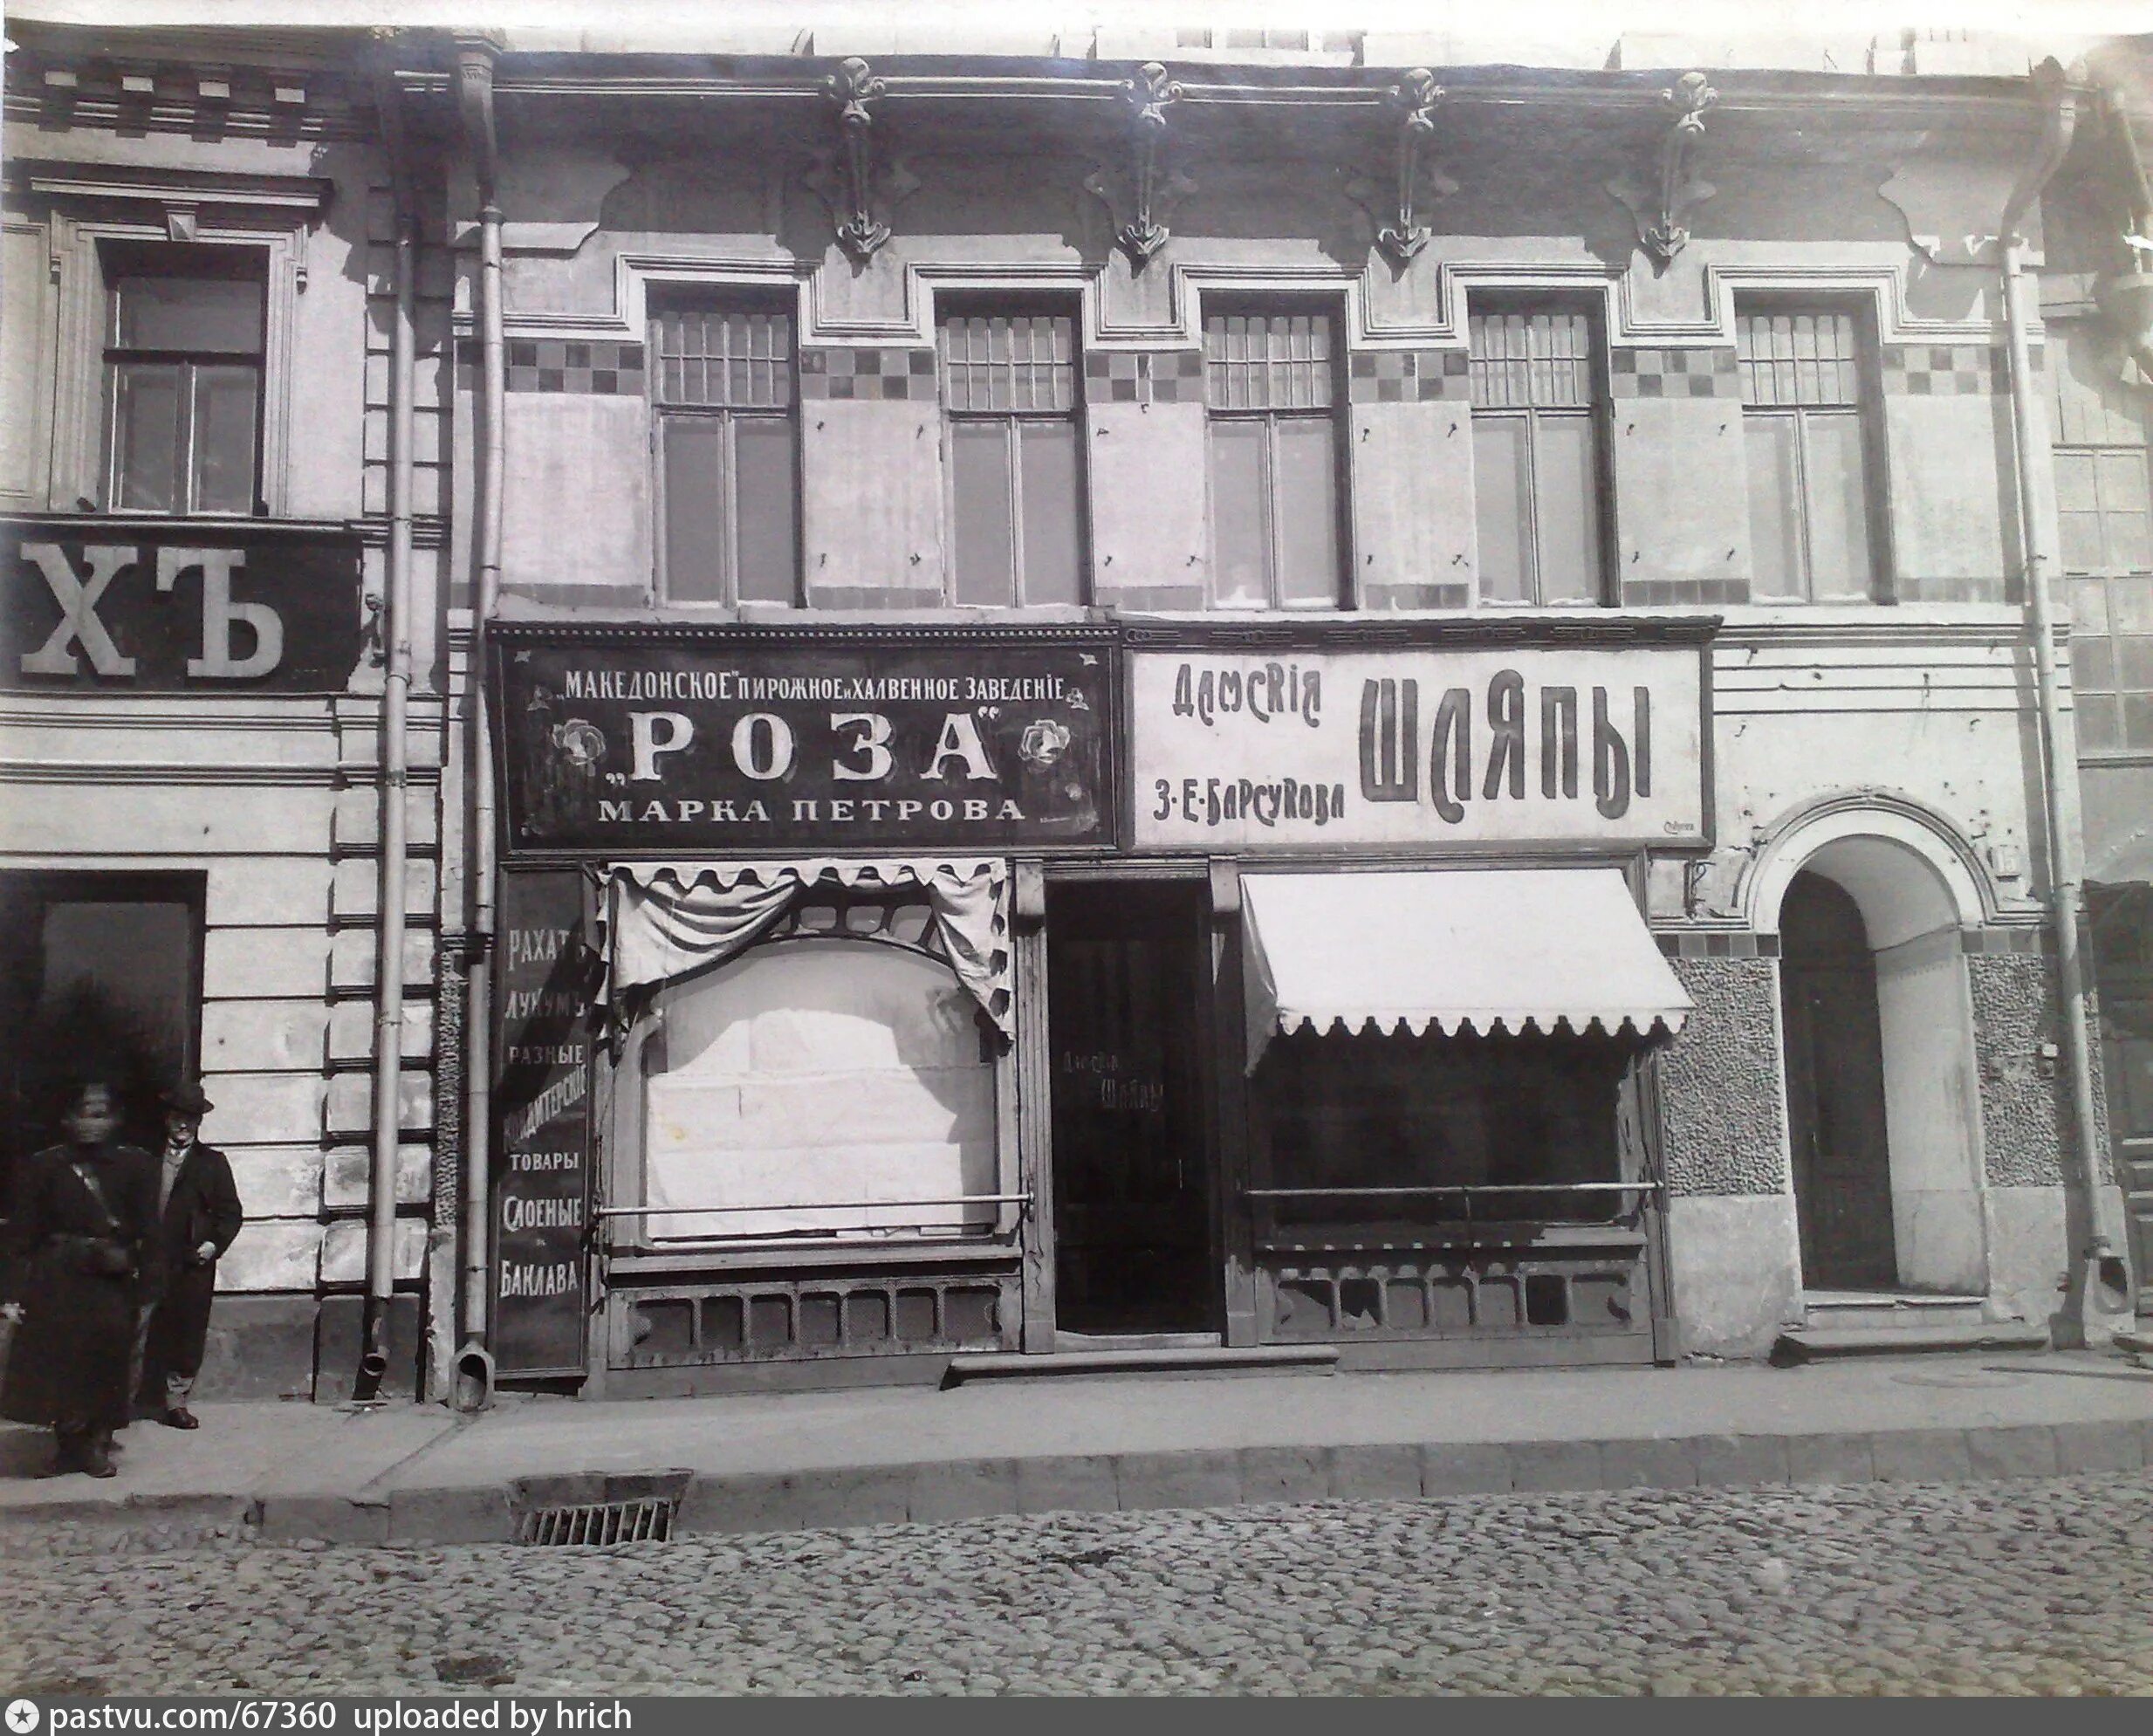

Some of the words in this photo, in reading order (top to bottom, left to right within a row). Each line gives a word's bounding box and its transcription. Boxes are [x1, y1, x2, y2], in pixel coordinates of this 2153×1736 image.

[20, 542, 284, 677] ХЪ
[738, 677, 843, 700] ПИРОЖНОЕ
[852, 677, 959, 701] ХАЛВЕННОЕ
[1358, 669, 1651, 824] ШЛЯПЫ
[598, 799, 771, 823] МАРКА
[792, 799, 1026, 823] ПЕТРОВА
[510, 1152, 579, 1171] ТОВАРЫ
[503, 1196, 582, 1232] СЛОЕНЫЕ
[499, 1259, 578, 1298] БАКЛАВА
